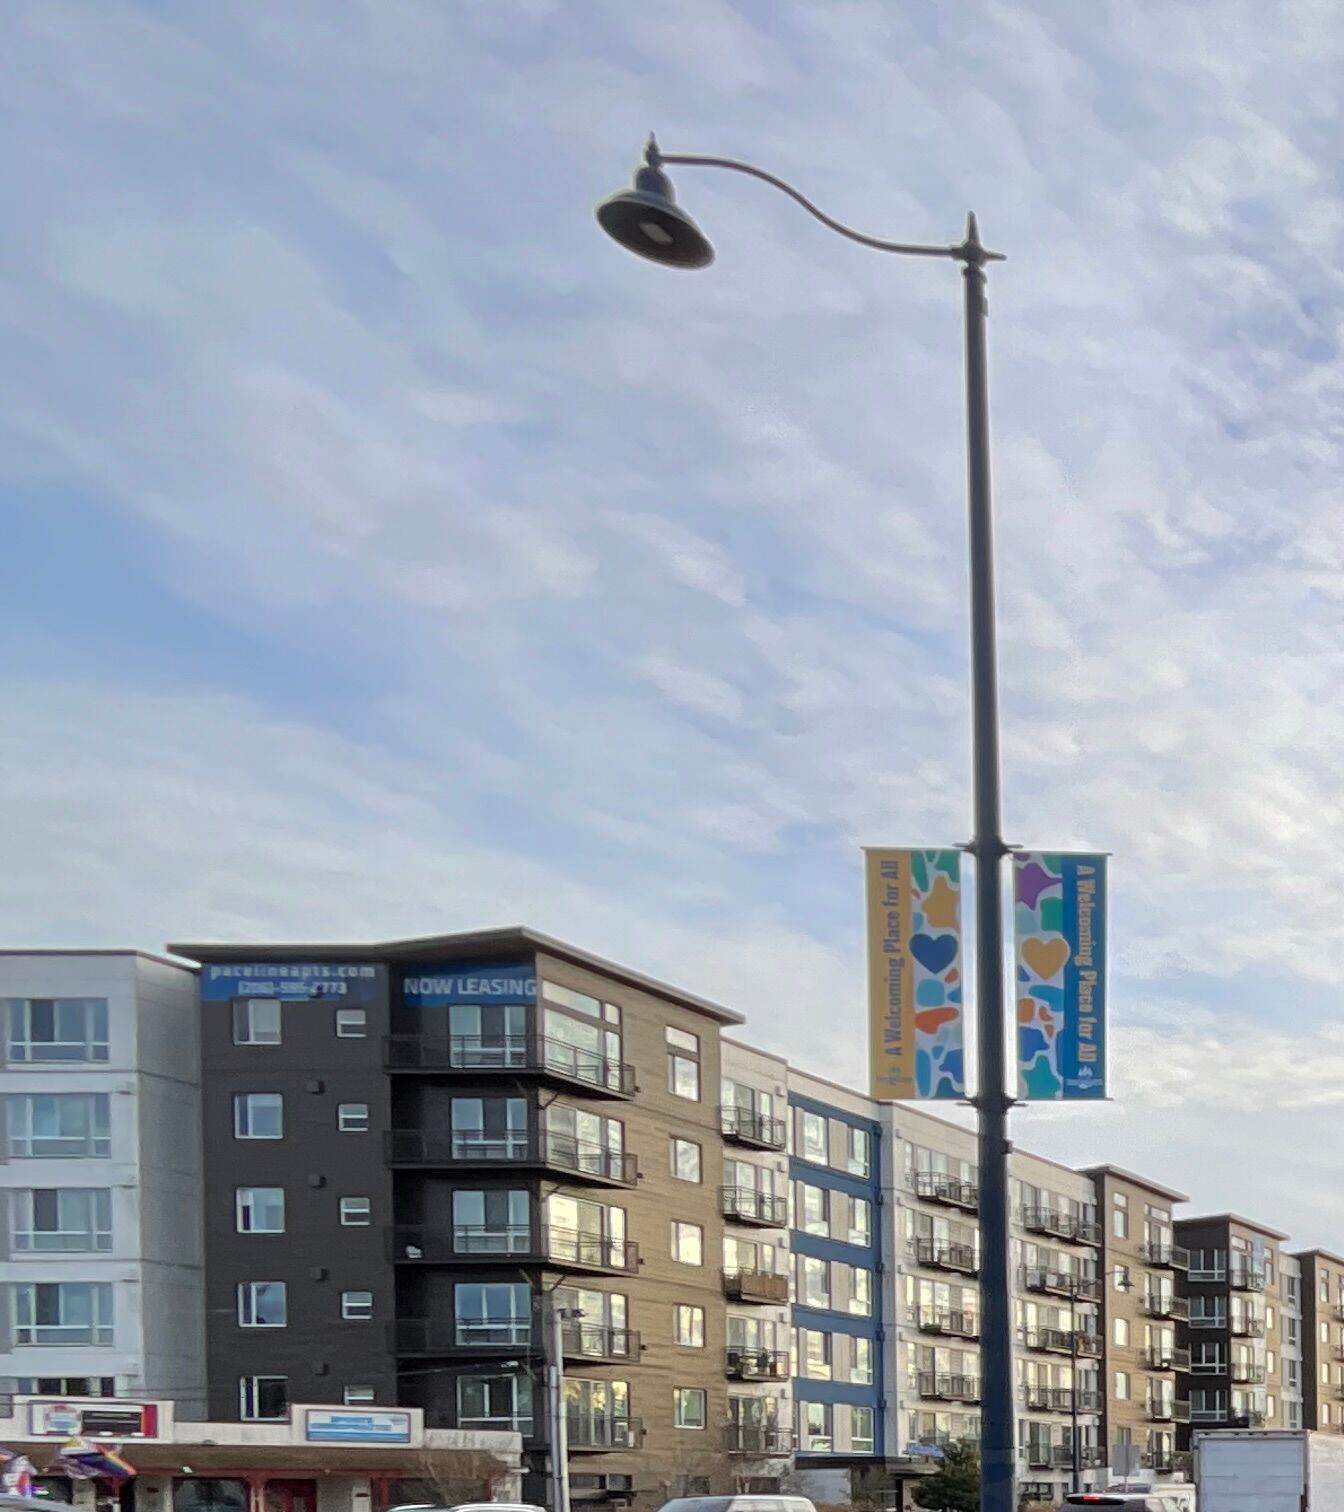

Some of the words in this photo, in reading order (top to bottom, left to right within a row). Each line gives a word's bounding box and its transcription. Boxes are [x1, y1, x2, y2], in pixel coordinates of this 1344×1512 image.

[880, 860, 898, 880] All
[1077, 865, 1095, 876] A
[881, 884, 899, 906] for
[883, 911, 900, 953] Place
[1075, 879, 1096, 967] Welcoming
[404, 977, 452, 995] NOW
[457, 977, 536, 996] LEASING
[1078, 970, 1097, 1013] Place
[884, 957, 905, 1043] Welcoming
[1078, 1016, 1097, 1040] for
[885, 1047, 902, 1056] A
[1078, 1041, 1097, 1062] All
